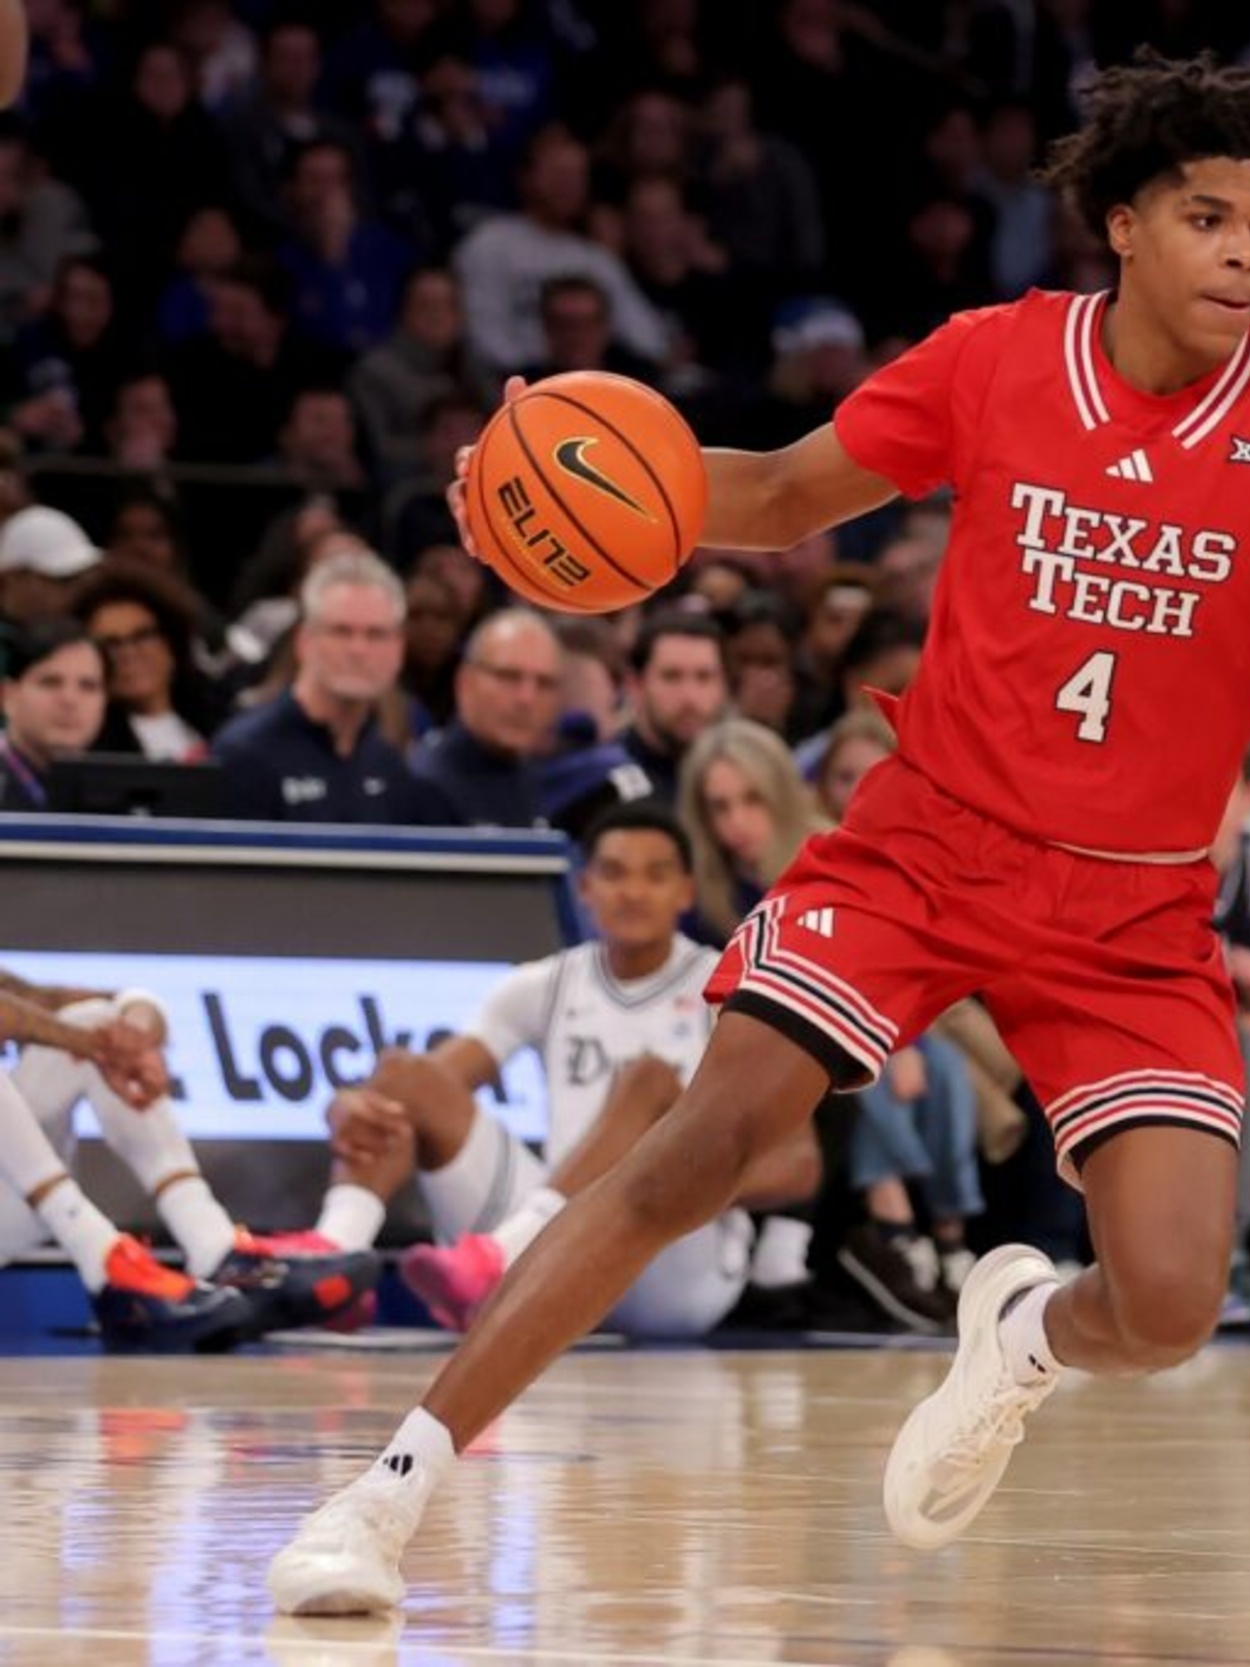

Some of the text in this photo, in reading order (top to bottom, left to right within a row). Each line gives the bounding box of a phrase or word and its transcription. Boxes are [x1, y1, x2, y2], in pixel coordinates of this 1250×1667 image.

[497, 476, 592, 587] ELITE
[1010, 482, 1237, 583] TEXAS
[1021, 548, 1200, 637] TECH
[1055, 650, 1116, 743] 4
